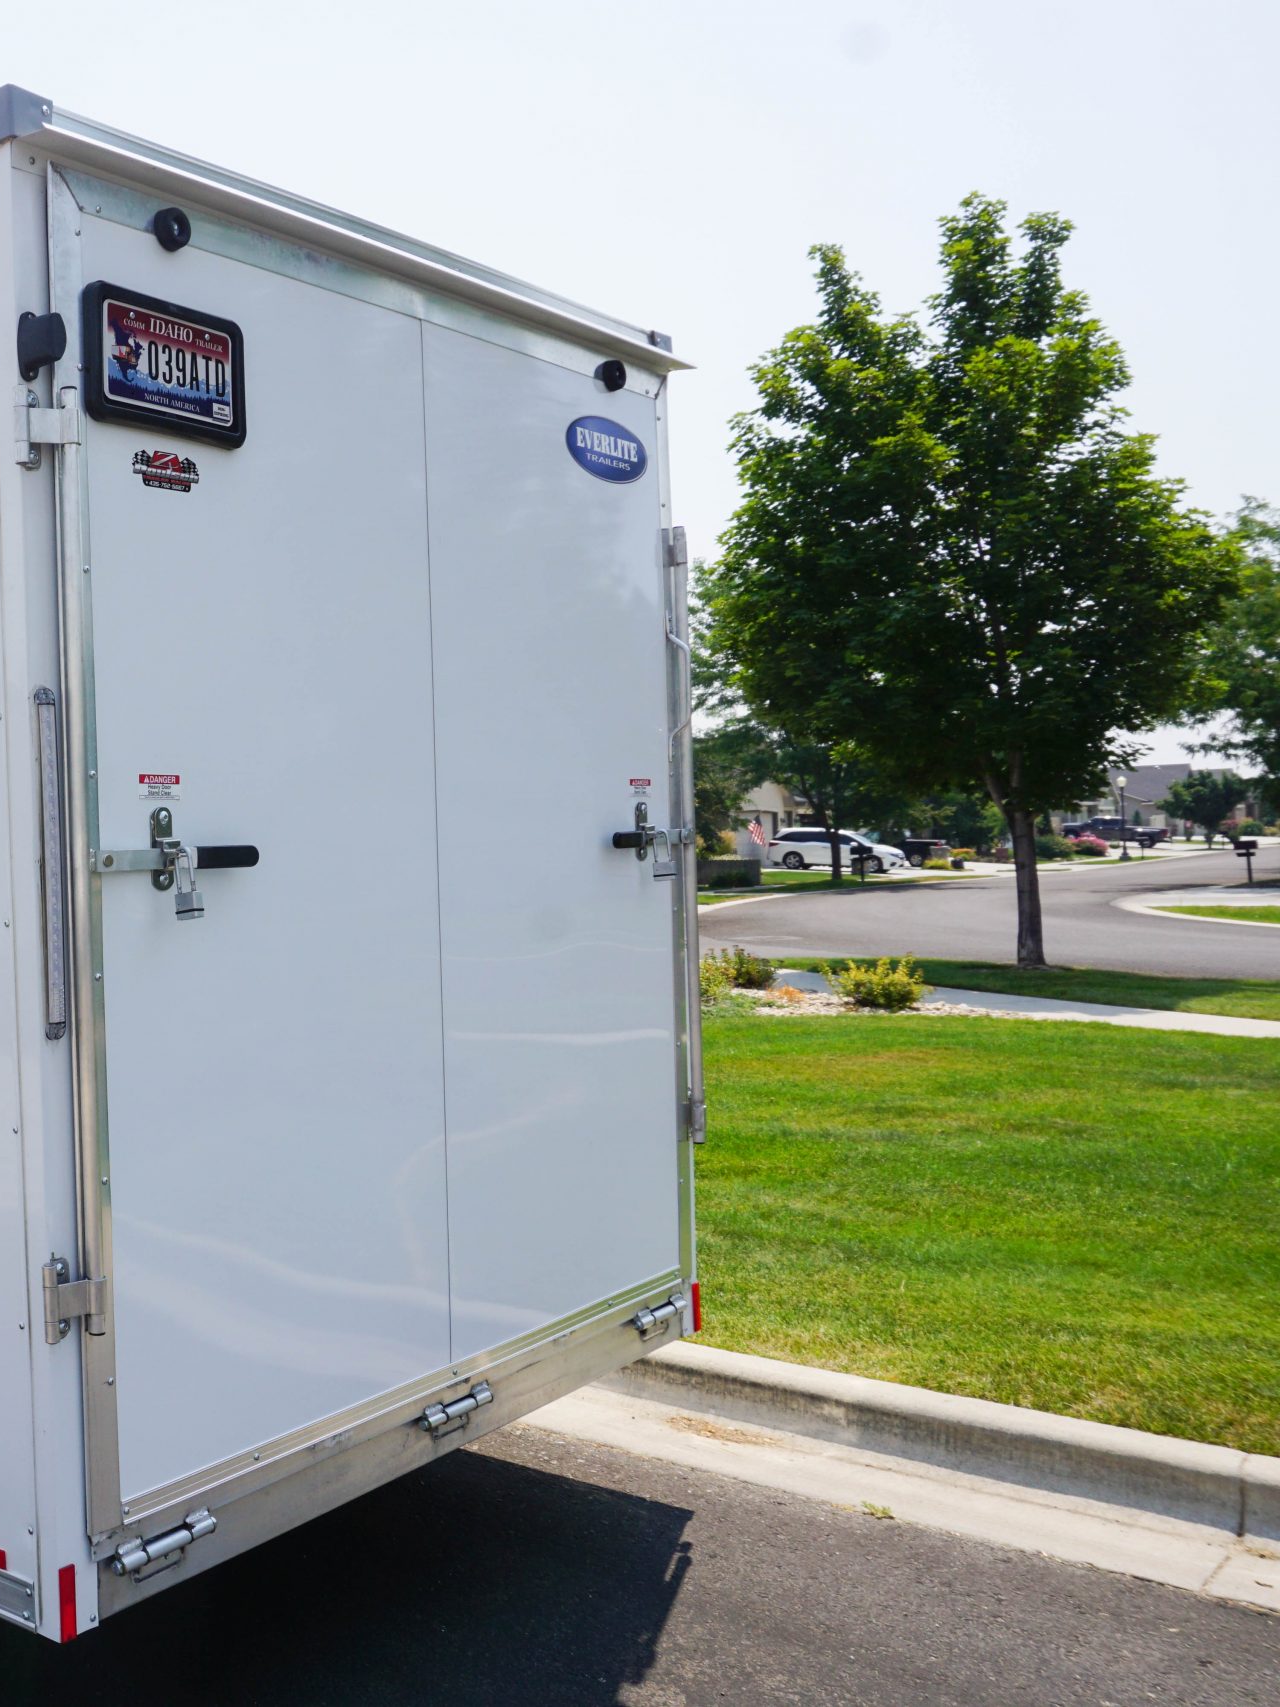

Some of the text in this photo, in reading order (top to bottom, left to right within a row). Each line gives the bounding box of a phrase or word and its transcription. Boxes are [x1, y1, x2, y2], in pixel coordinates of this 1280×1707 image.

[123, 318, 145, 331] COMM
[149, 317, 193, 343] IDAHO
[195, 338, 223, 353] TRAILER
[147, 340, 226, 398] 039ATD
[144, 392, 169, 406] NORTH
[170, 399, 201, 413] AMERICA
[576, 426, 638, 463] EVERLITE
[585, 452, 631, 471] TRAILERS
[149, 775, 176, 784] DANGER
